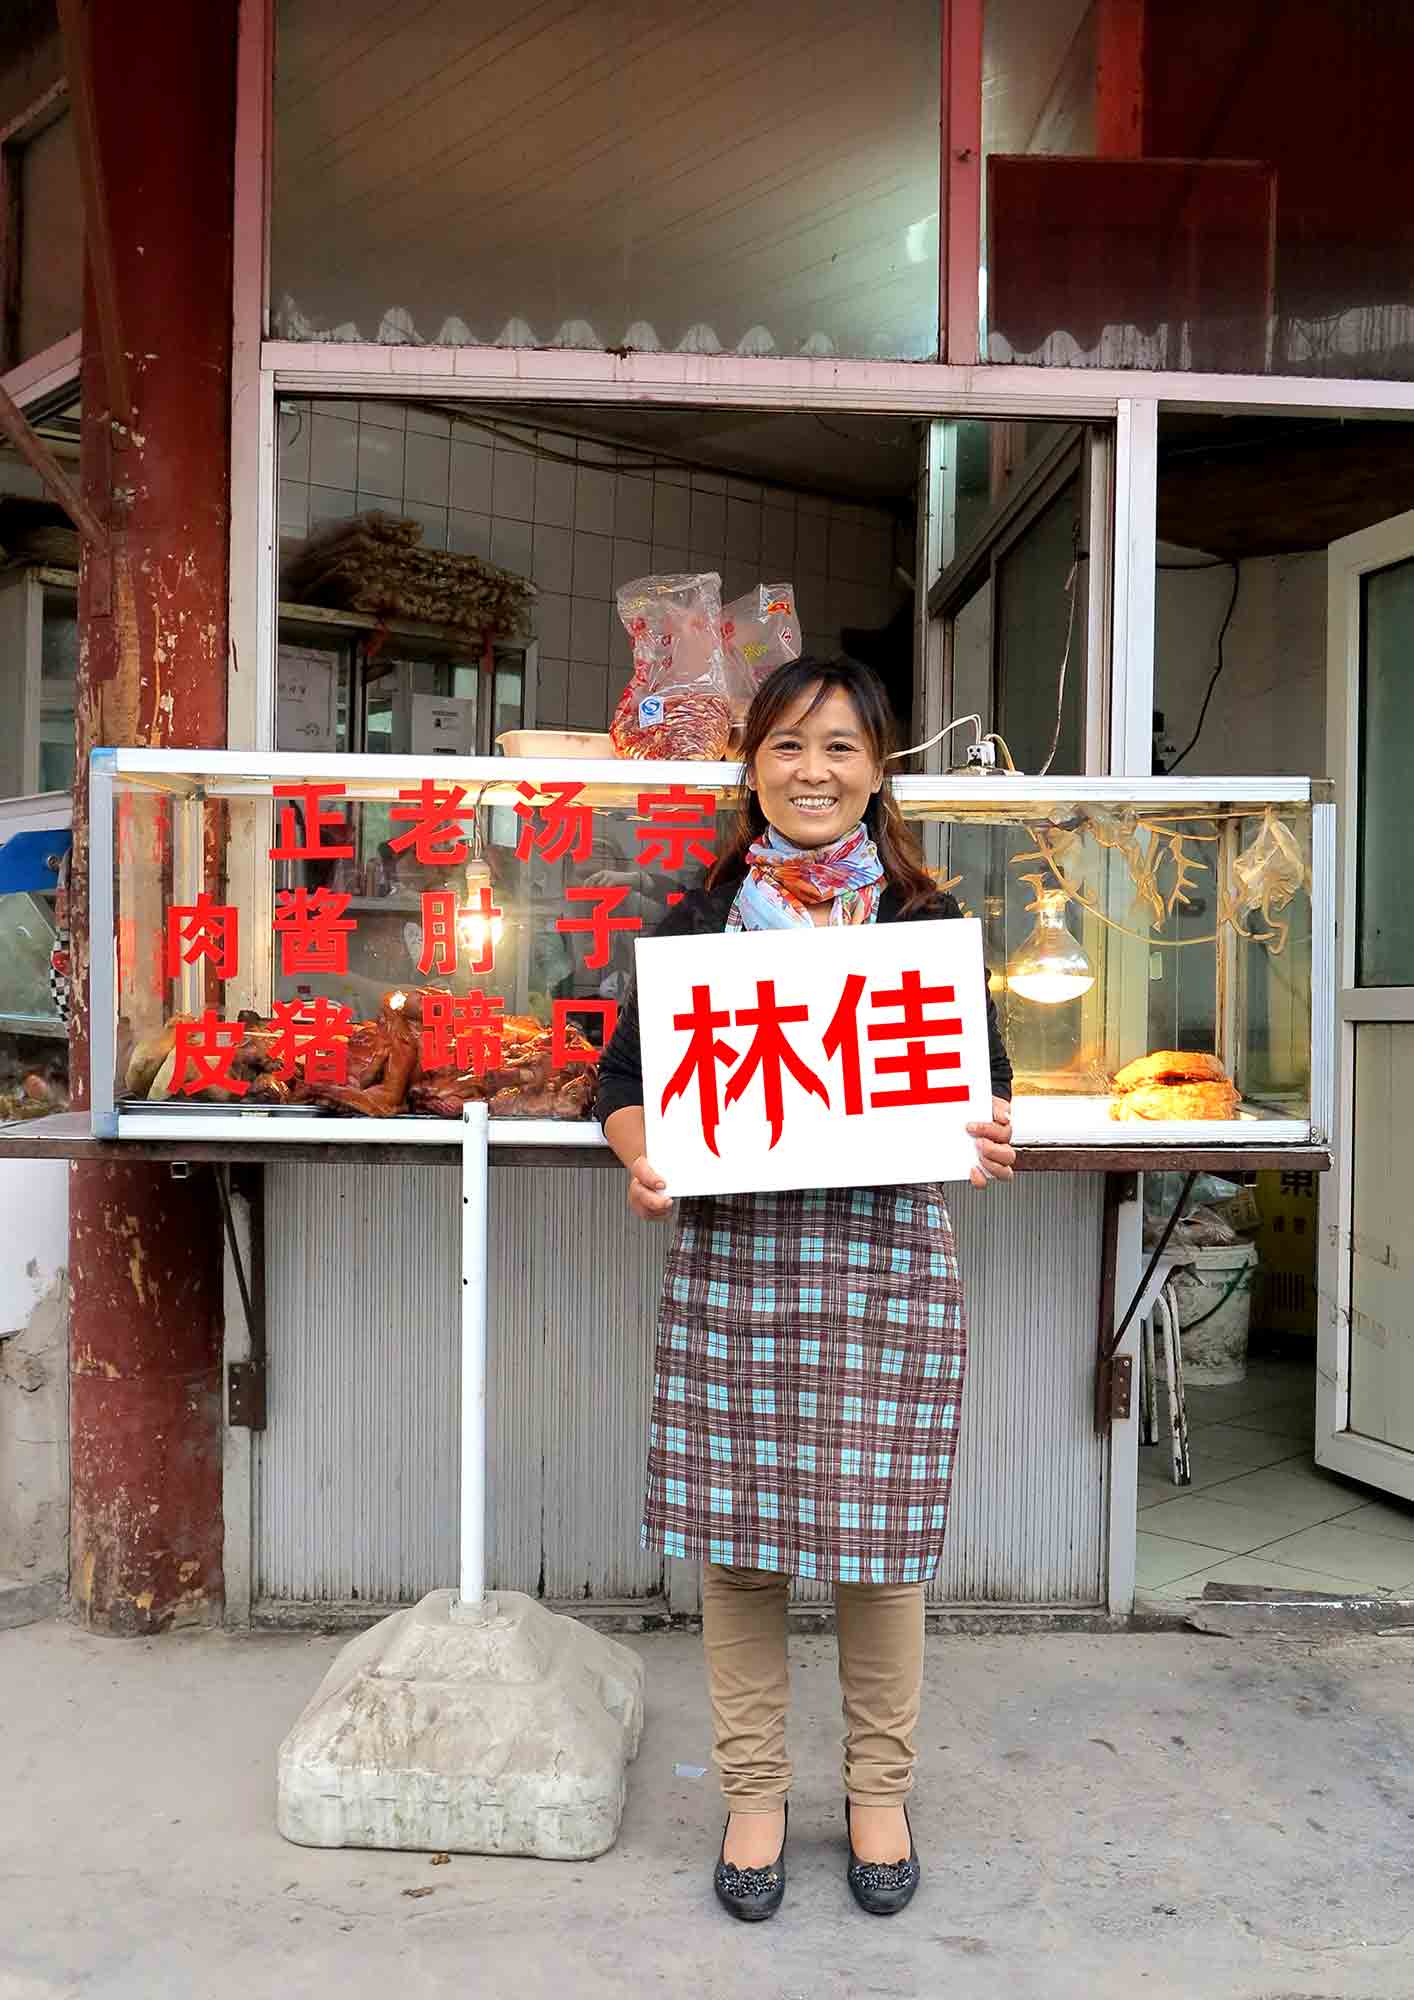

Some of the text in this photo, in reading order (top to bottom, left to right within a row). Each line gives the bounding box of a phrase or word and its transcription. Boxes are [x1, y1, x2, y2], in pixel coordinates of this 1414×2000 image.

[168, 886, 685, 981] 肉酱肘子
[661, 970, 970, 1158] 林佳
